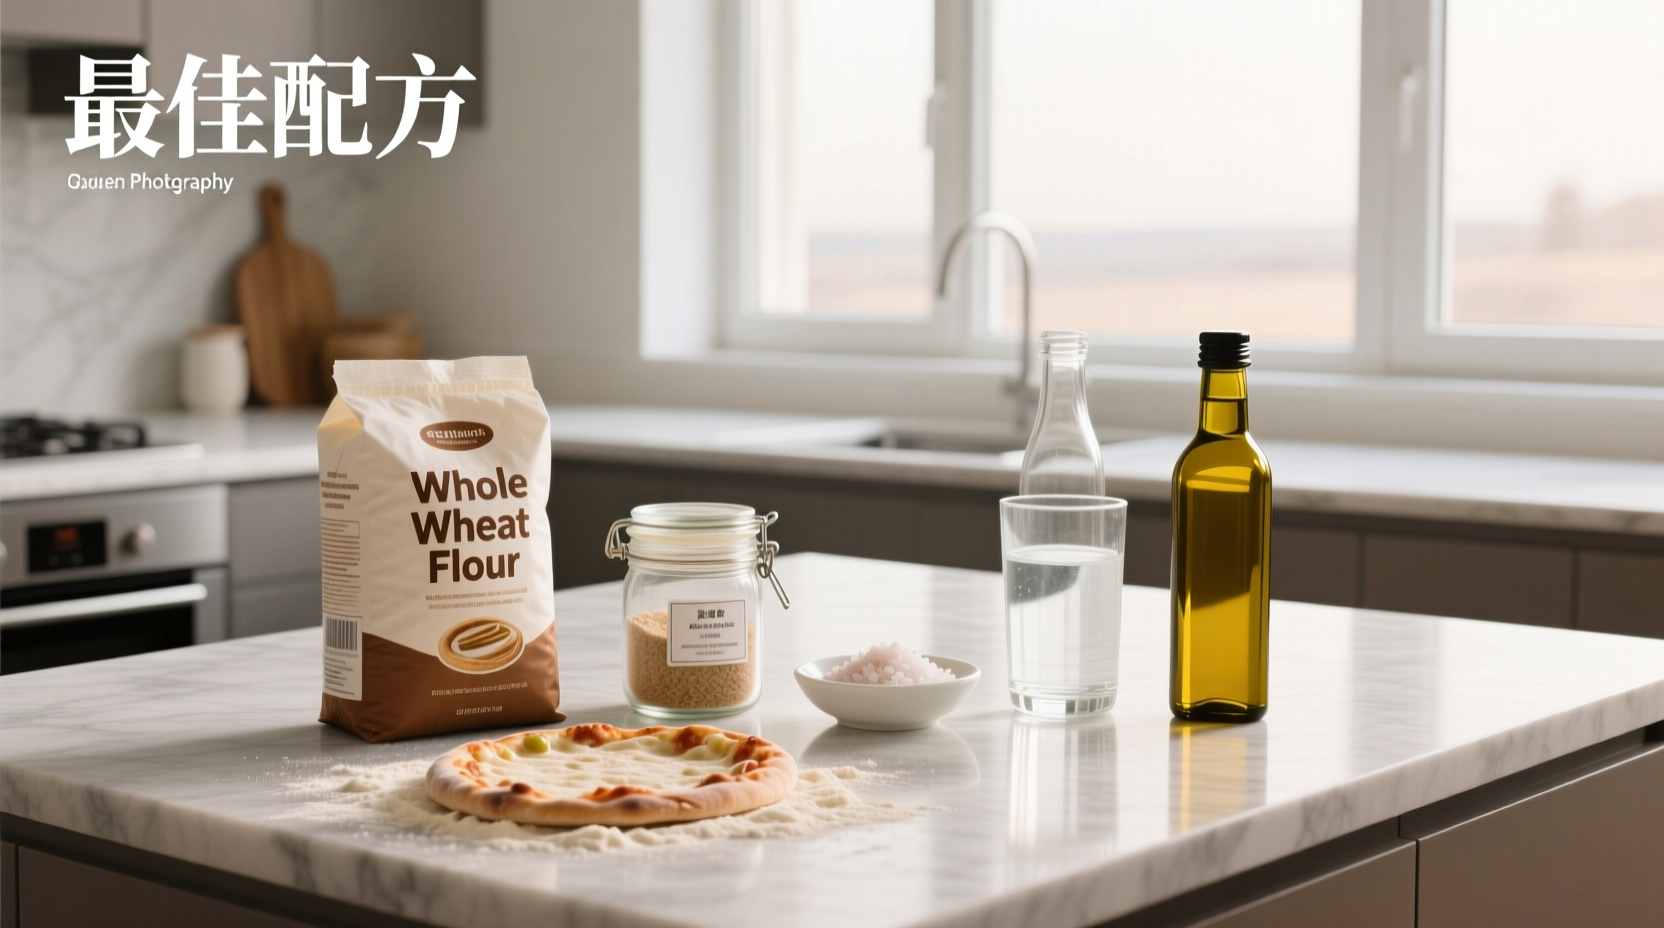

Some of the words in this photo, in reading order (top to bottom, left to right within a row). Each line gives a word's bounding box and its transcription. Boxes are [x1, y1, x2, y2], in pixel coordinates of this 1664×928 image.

[410, 466, 528, 504] Whole
[410, 508, 530, 545] Wheat
[429, 548, 521, 584] Flour
